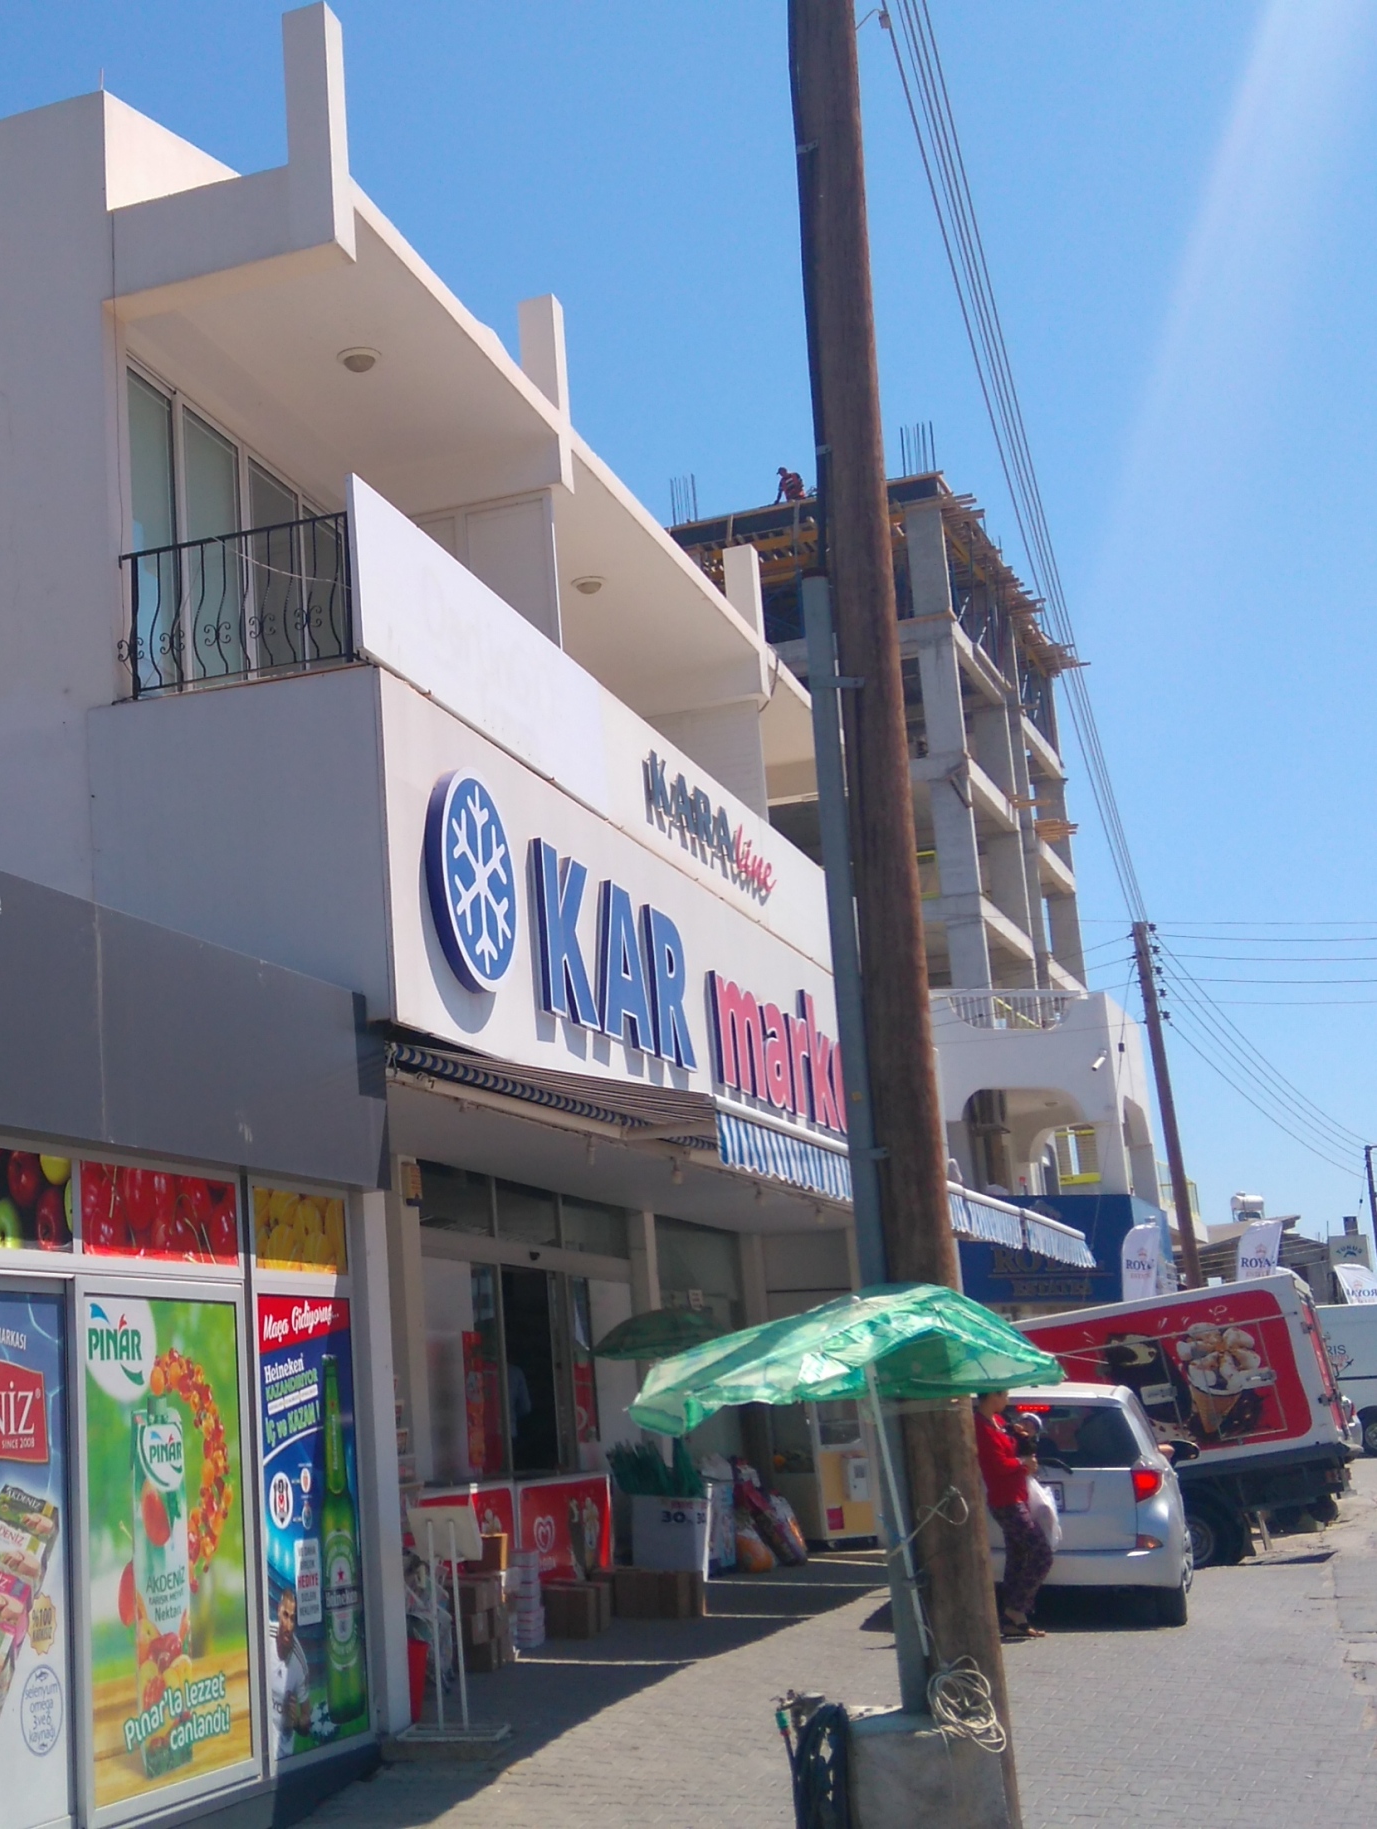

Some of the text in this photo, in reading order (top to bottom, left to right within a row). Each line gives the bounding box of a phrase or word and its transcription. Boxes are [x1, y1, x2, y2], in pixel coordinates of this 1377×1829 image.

[532, 838, 848, 1134] KAR mark
[1241, 1257, 1276, 1268] ROYA
[88, 1325, 143, 1361] PINAR
[263, 1313, 290, 1343] Maça
[263, 1357, 305, 1385] Heineken
[1, 1437, 35, 1450] SINCE 2008
[149, 1441, 182, 1464] PINAR
[124, 1673, 226, 1750] Pınar'la lezzet
[169, 1706, 231, 1750] canlandı!
